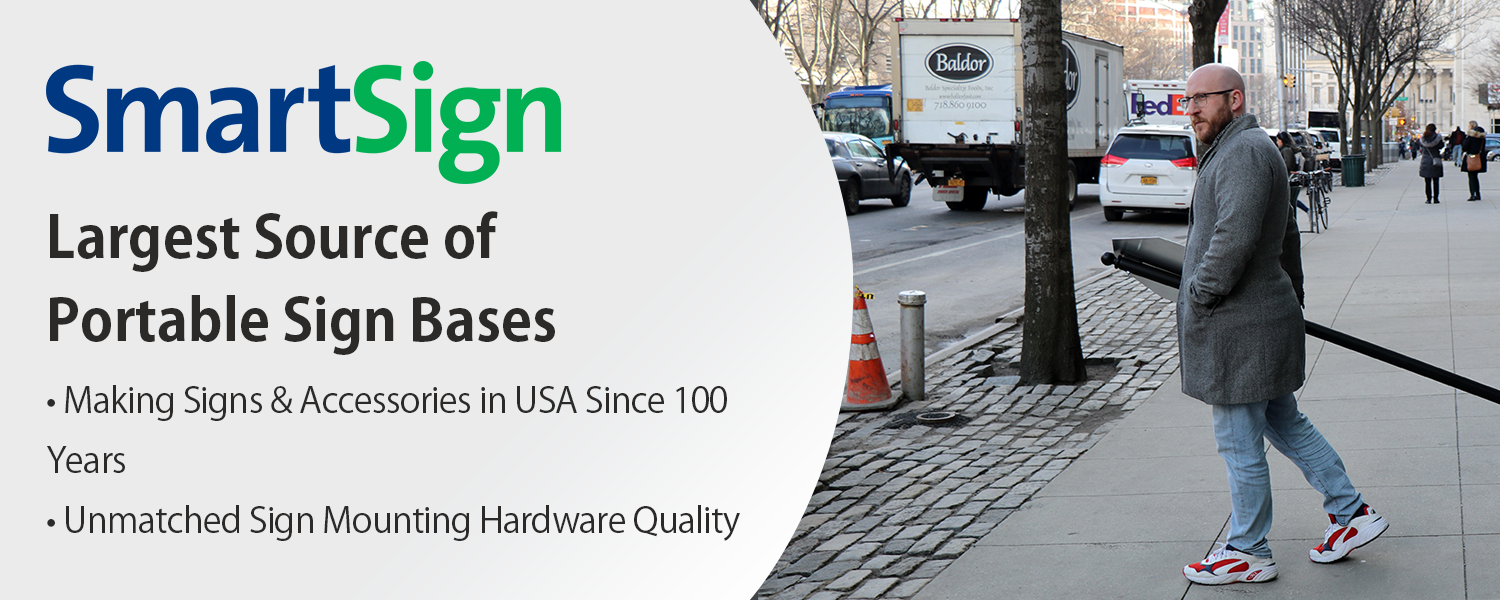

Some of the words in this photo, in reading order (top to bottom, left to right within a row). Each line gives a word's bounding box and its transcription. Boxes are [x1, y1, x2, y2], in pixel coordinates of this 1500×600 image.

[936, 52, 987, 71] Baldor
[966, 101, 987, 111] 9100
[1131, 93, 1189, 116] FedE
